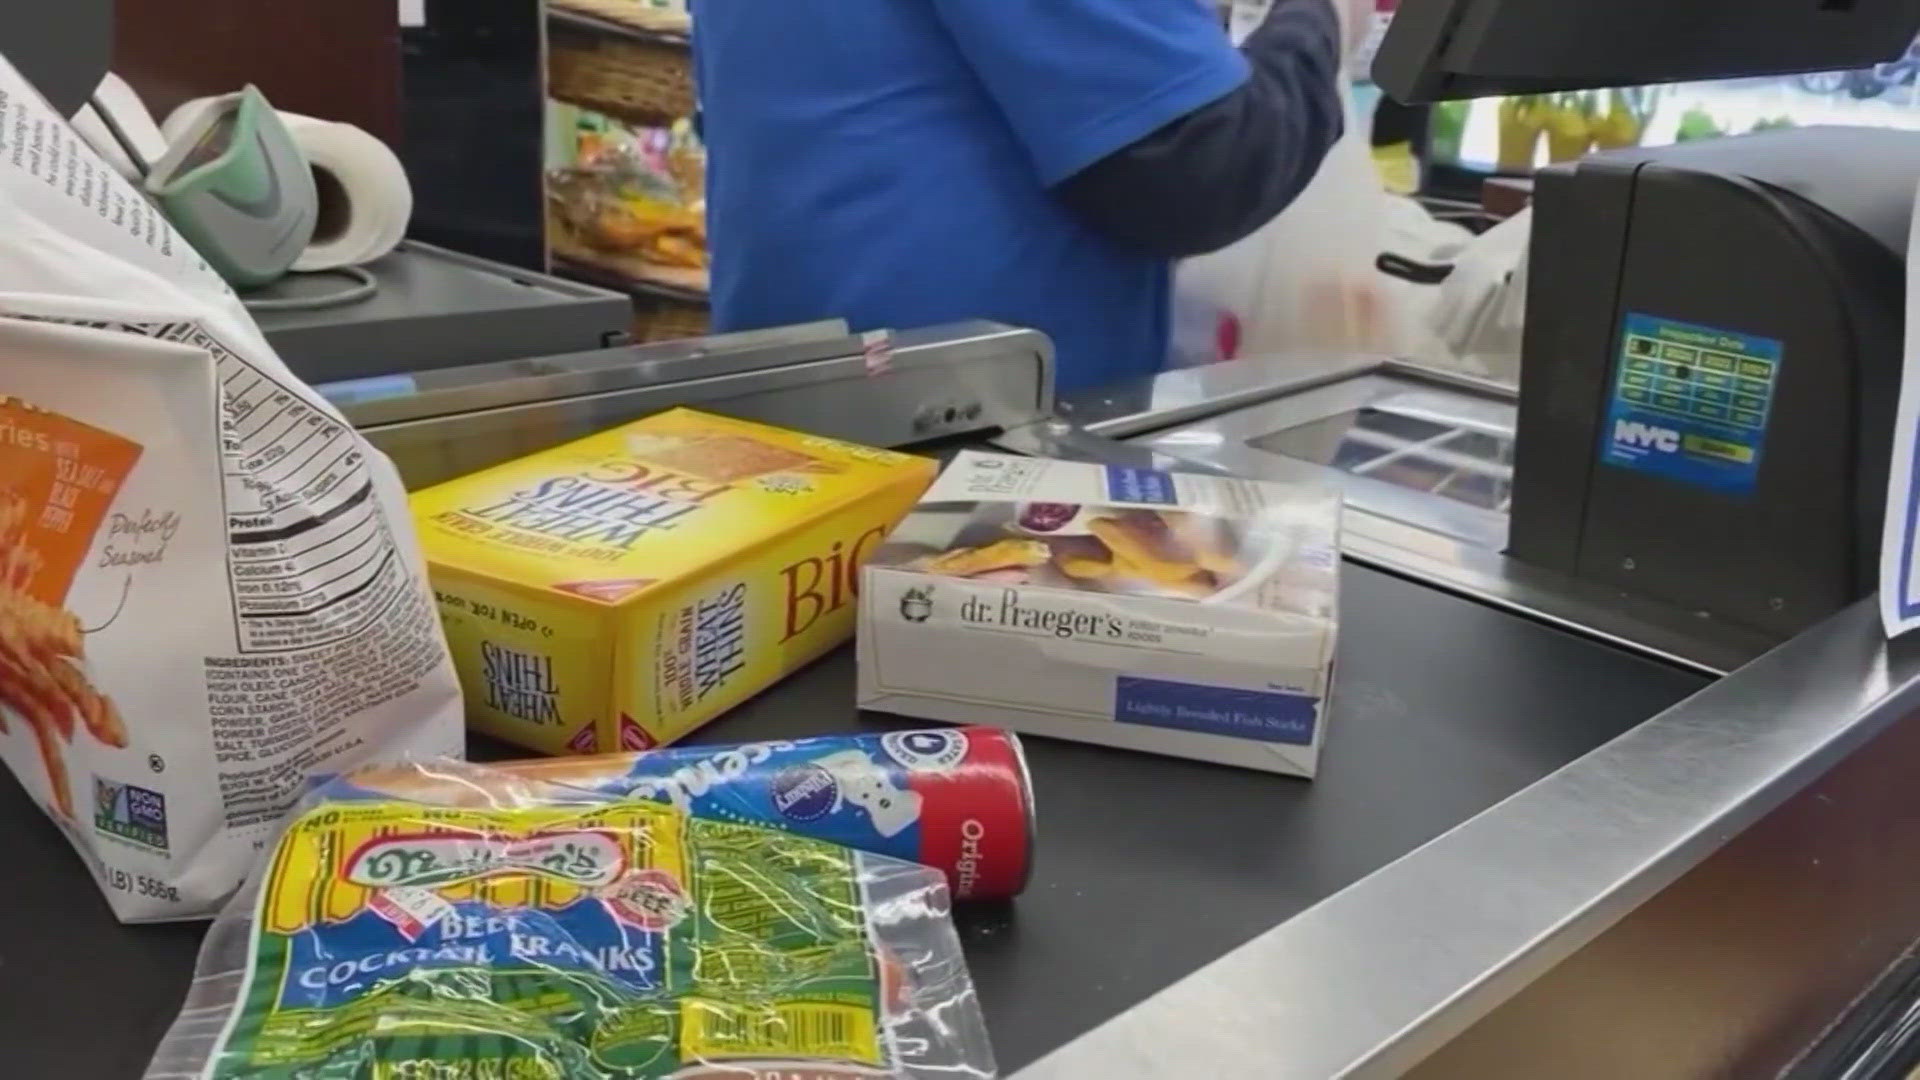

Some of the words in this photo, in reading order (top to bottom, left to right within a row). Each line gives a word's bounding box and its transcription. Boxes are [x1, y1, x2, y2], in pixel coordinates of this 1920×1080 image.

[1613, 418, 1680, 454] NYC
[514, 476, 699, 531] THINS
[452, 496, 648, 552] WHEAT
[233, 565, 282, 577] Calcium
[236, 582, 260, 593] Iron
[238, 599, 300, 611] Potassium
[469, 599, 496, 620] FOR
[501, 611, 537, 632] OPEN
[960, 599, 994, 625] dr.
[1000, 586, 1123, 637] Praeger's
[694, 599, 720, 702] WHEAT
[718, 582, 747, 687] THINS
[480, 639, 560, 695] THINS
[208, 704, 245, 716] CORN
[484, 678, 566, 727] WHEAT
[1126, 700, 1172, 719] Lightly
[1175, 705, 1232, 725] Breaded
[1233, 712, 1263, 728] Fish
[1264, 715, 1307, 732] Sticks
[130, 790, 163, 808] NON
[776, 769, 833, 813] Pillsbury
[131, 802, 164, 822] GMO
[301, 810, 341, 833] NO
[300, 945, 494, 989] COCKTAIL
[510, 931, 655, 972] FRANKS
